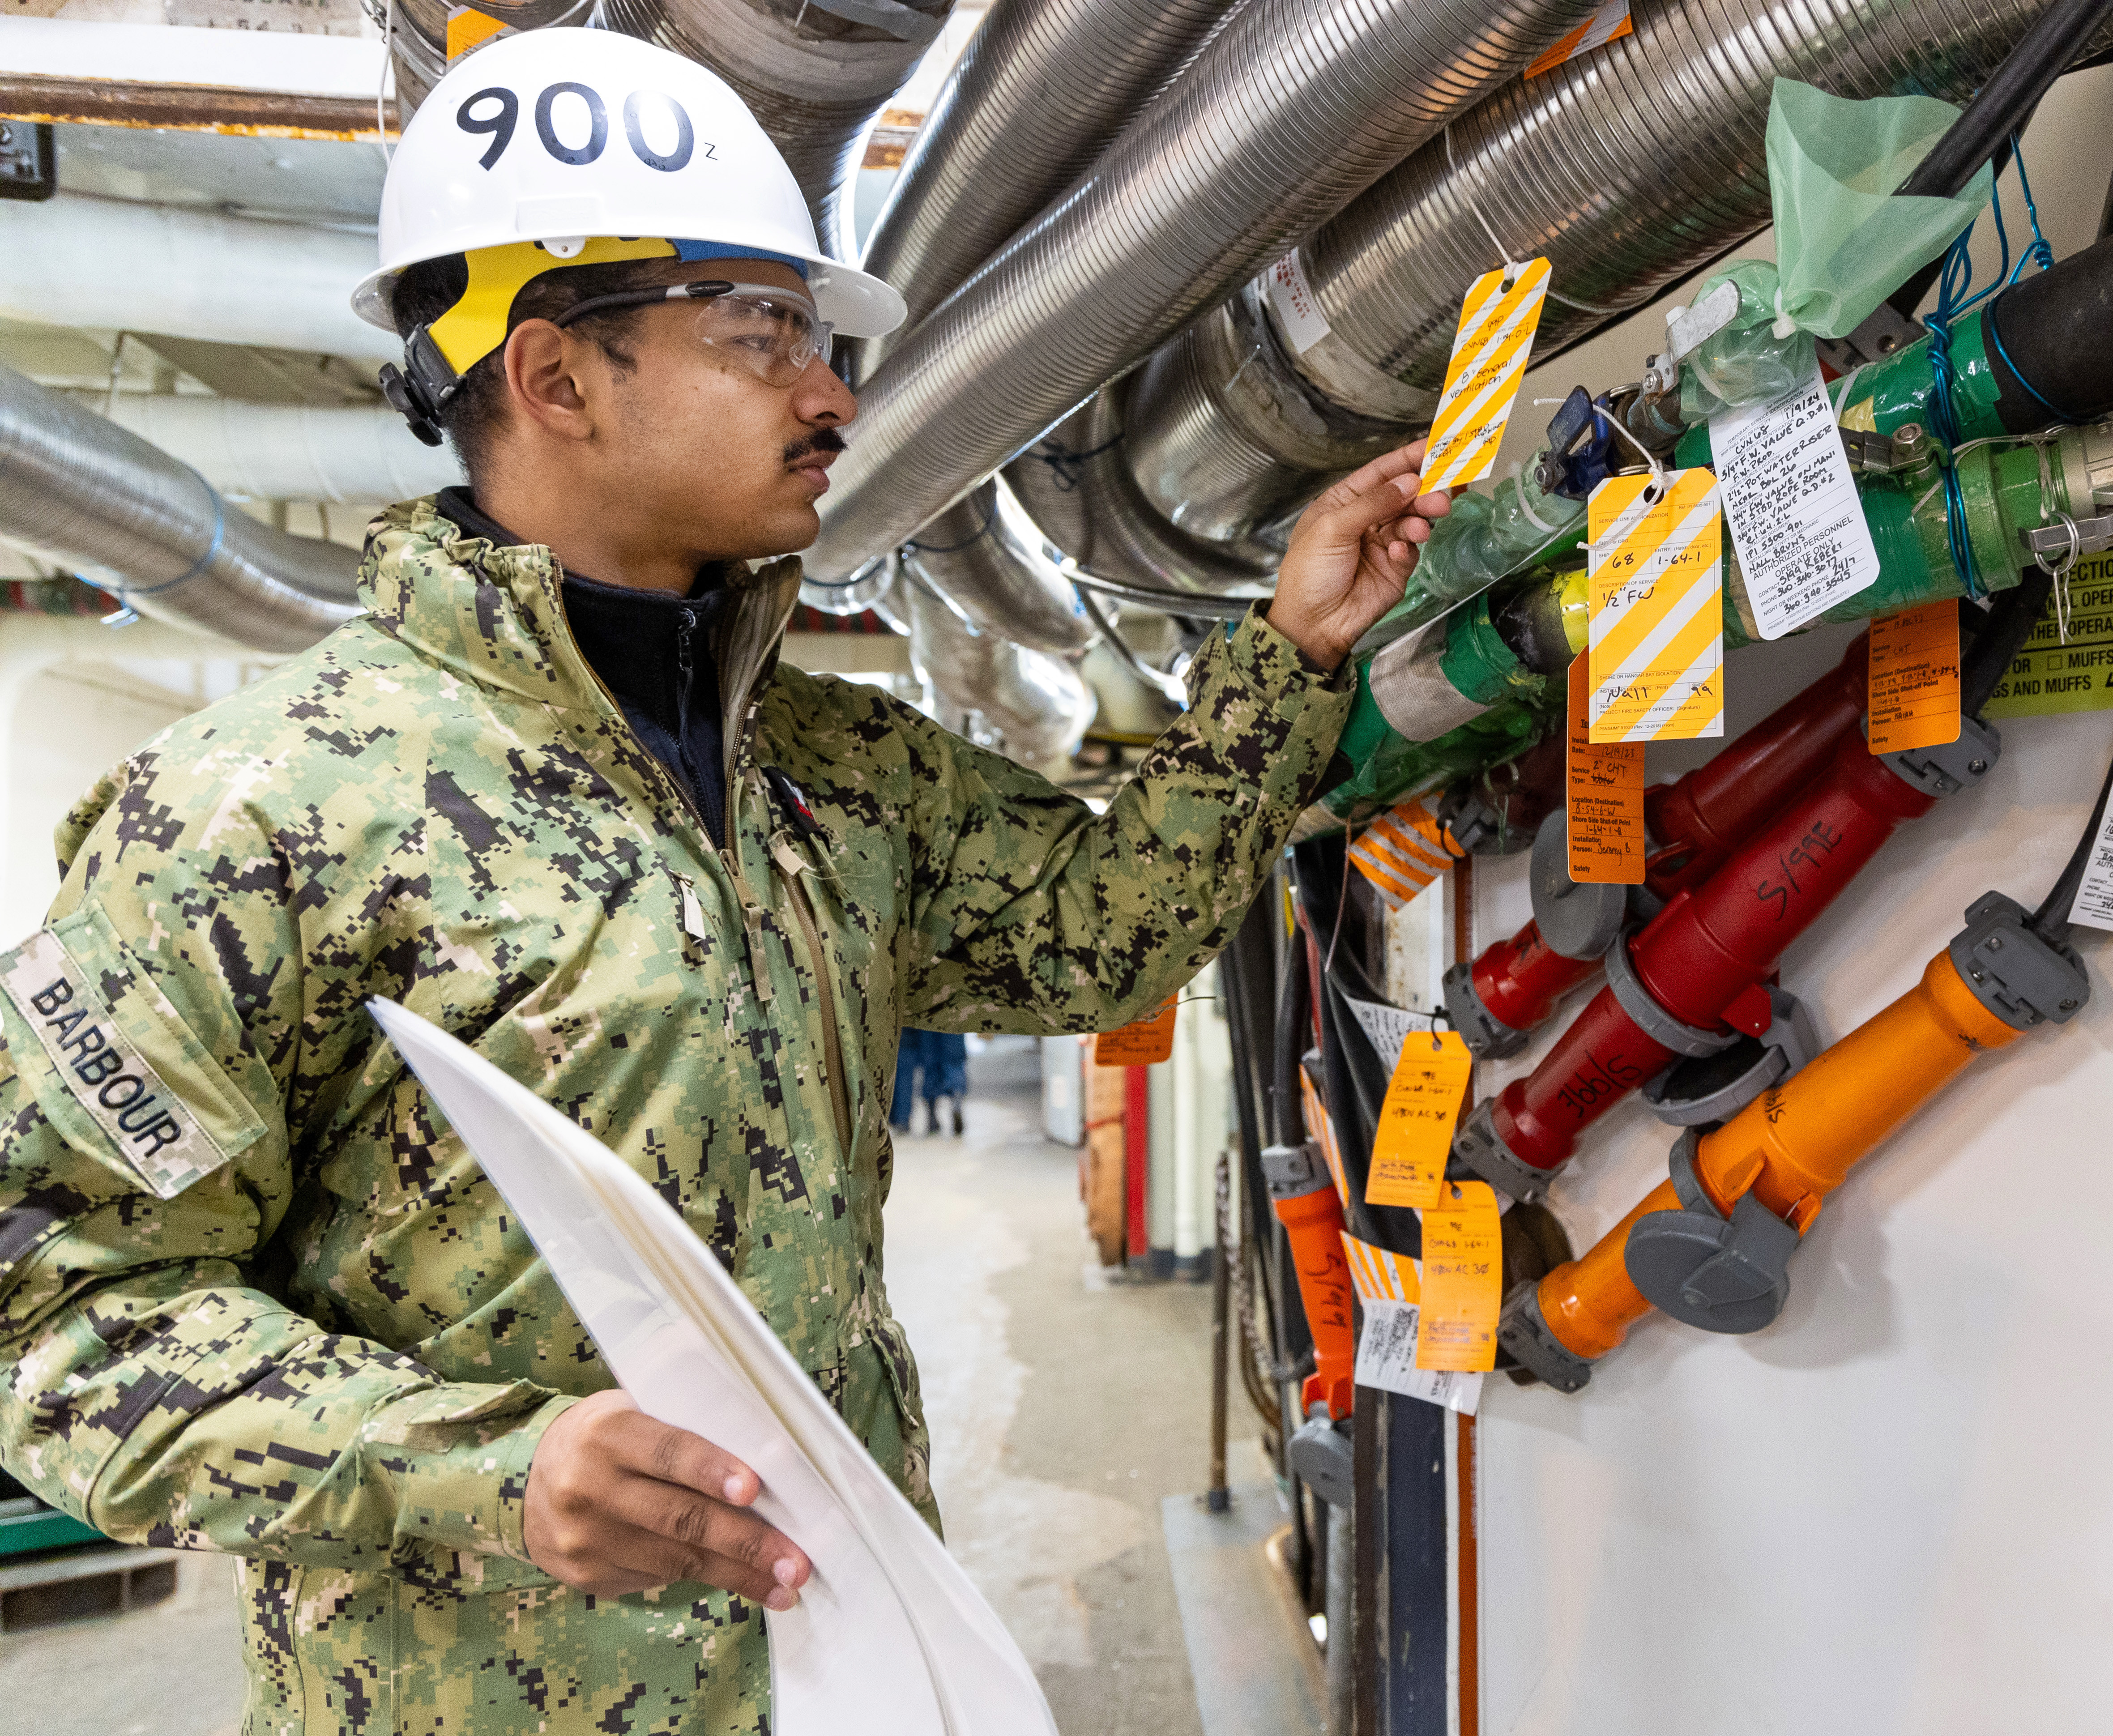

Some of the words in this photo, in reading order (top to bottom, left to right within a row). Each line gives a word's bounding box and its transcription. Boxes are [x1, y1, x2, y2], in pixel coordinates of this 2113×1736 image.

[457, 82, 694, 172] 900
[1727, 424, 1750, 445] TEMPORARY
[1750, 412, 1768, 427] SERVICE
[1769, 389, 1803, 414] IDENTIFICATION
[1784, 402, 1795, 412] DATE
[1786, 391, 1820, 419] 1/9/24
[1720, 448, 1729, 457] SHIP
[1729, 441, 1738, 451] (HULL
[1754, 417, 1771, 431] FACILITY
[1723, 450, 1745, 469] TEMPORARY
[1746, 438, 1762, 452] SERVICE
[1763, 418, 1794, 440] IDENTIFICATION
[1761, 423, 1793, 450] VALVE
[1749, 448, 1775, 471] PROD.
[1729, 479, 1742, 491] SHORE
[1742, 468, 1758, 482] SOURCE
[1758, 453, 1780, 471] (LOCATION)
[1765, 476, 1793, 500] VALVE
[1798, 464, 1811, 479] ON
[1735, 502, 1748, 513] SERVICE
[1748, 493, 1763, 504] FROM
[1737, 519, 1746, 529] IN
[1776, 482, 1800, 503] ROPE
[1803, 468, 1827, 486] ROOM
[1770, 494, 1797, 519] VALVE
[1631, 512, 1668, 520] AHORIZATION
[1740, 520, 1755, 532] SERVICE
[1745, 534, 1767, 551] INSTALLING
[1768, 520, 1790, 537] DOCUMENT
[1749, 547, 1772, 564] INSTALLING
[1772, 536, 1790, 550] ACTIVITY
[1797, 518, 1818, 534] MECHANIC
[1753, 545, 1801, 580] AUTHORIZED
[1803, 515, 1853, 549] PERSONNEL
[1612, 552, 1634, 568] 68
[1658, 551, 1700, 566] 1-64-1
[1775, 550, 1811, 578] OPERATE
[1813, 537, 1835, 555] ONLY
[1832, 557, 1855, 576] 24/7
[1627, 586, 1654, 603] FW
[1758, 581, 1780, 598] CONTACT
[1761, 593, 1777, 607] PHONE
[1763, 604, 1778, 616] NIGHT
[1786, 585, 1811, 602] WEEKEND
[1811, 574, 1829, 588] PHONE
[2069, 650, 2113, 668] MUFFS
[2014, 681, 2040, 696] AND
[2046, 675, 2091, 693] MUFFS
[1572, 776, 1585, 784] Type:
[1607, 762, 1626, 777] CHT
[1594, 798, 1624, 807] (Destination)
[30, 977, 181, 1158] BARBOUR
